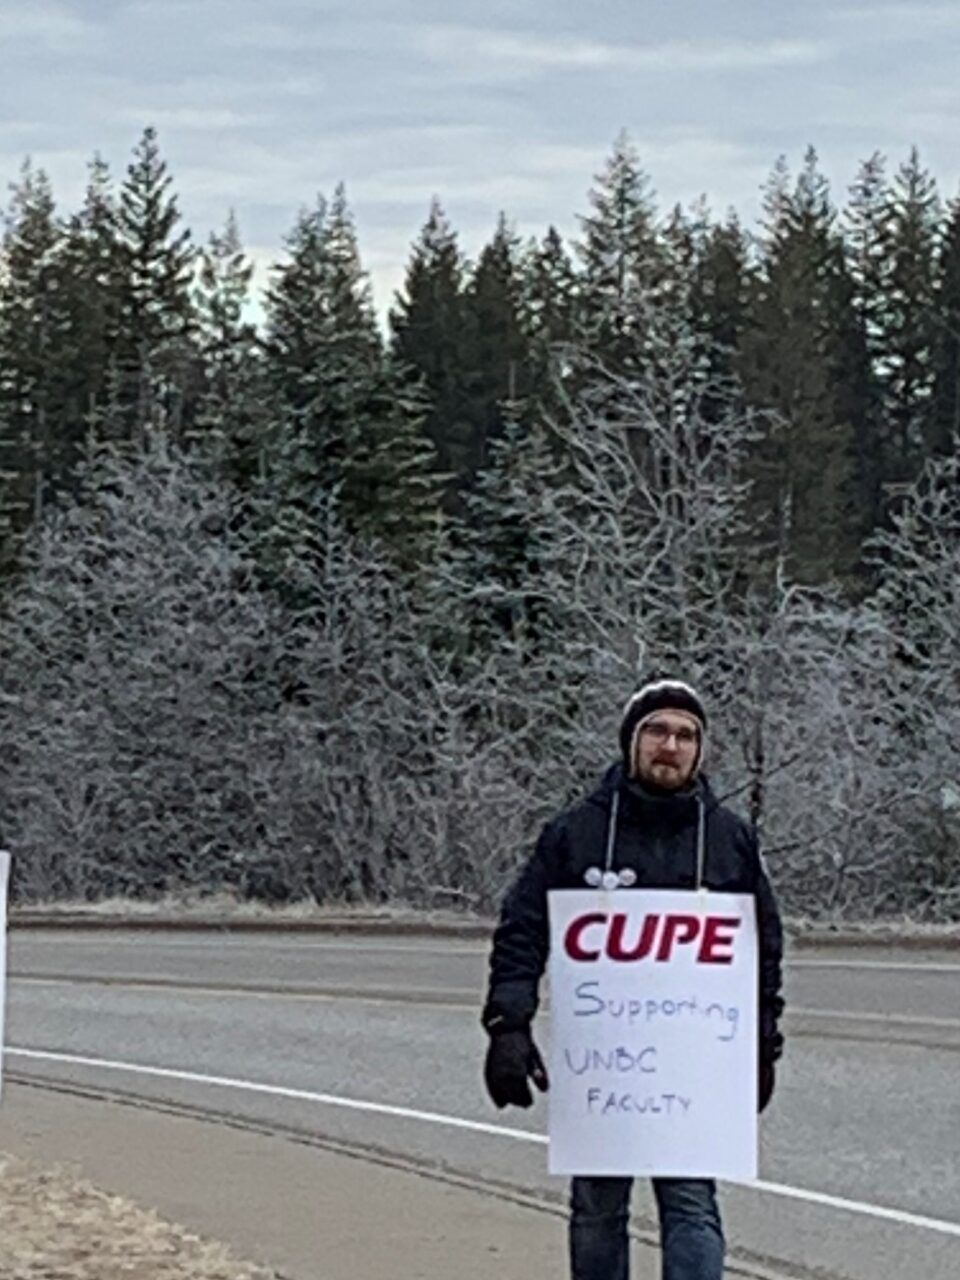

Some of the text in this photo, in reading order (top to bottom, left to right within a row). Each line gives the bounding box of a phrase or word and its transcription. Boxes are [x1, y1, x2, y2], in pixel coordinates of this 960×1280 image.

[564, 913, 742, 964] CUPE
[574, 982, 739, 1042] Supporting
[564, 1047, 658, 1075] UNBC
[587, 1088, 692, 1114] FACULTY
